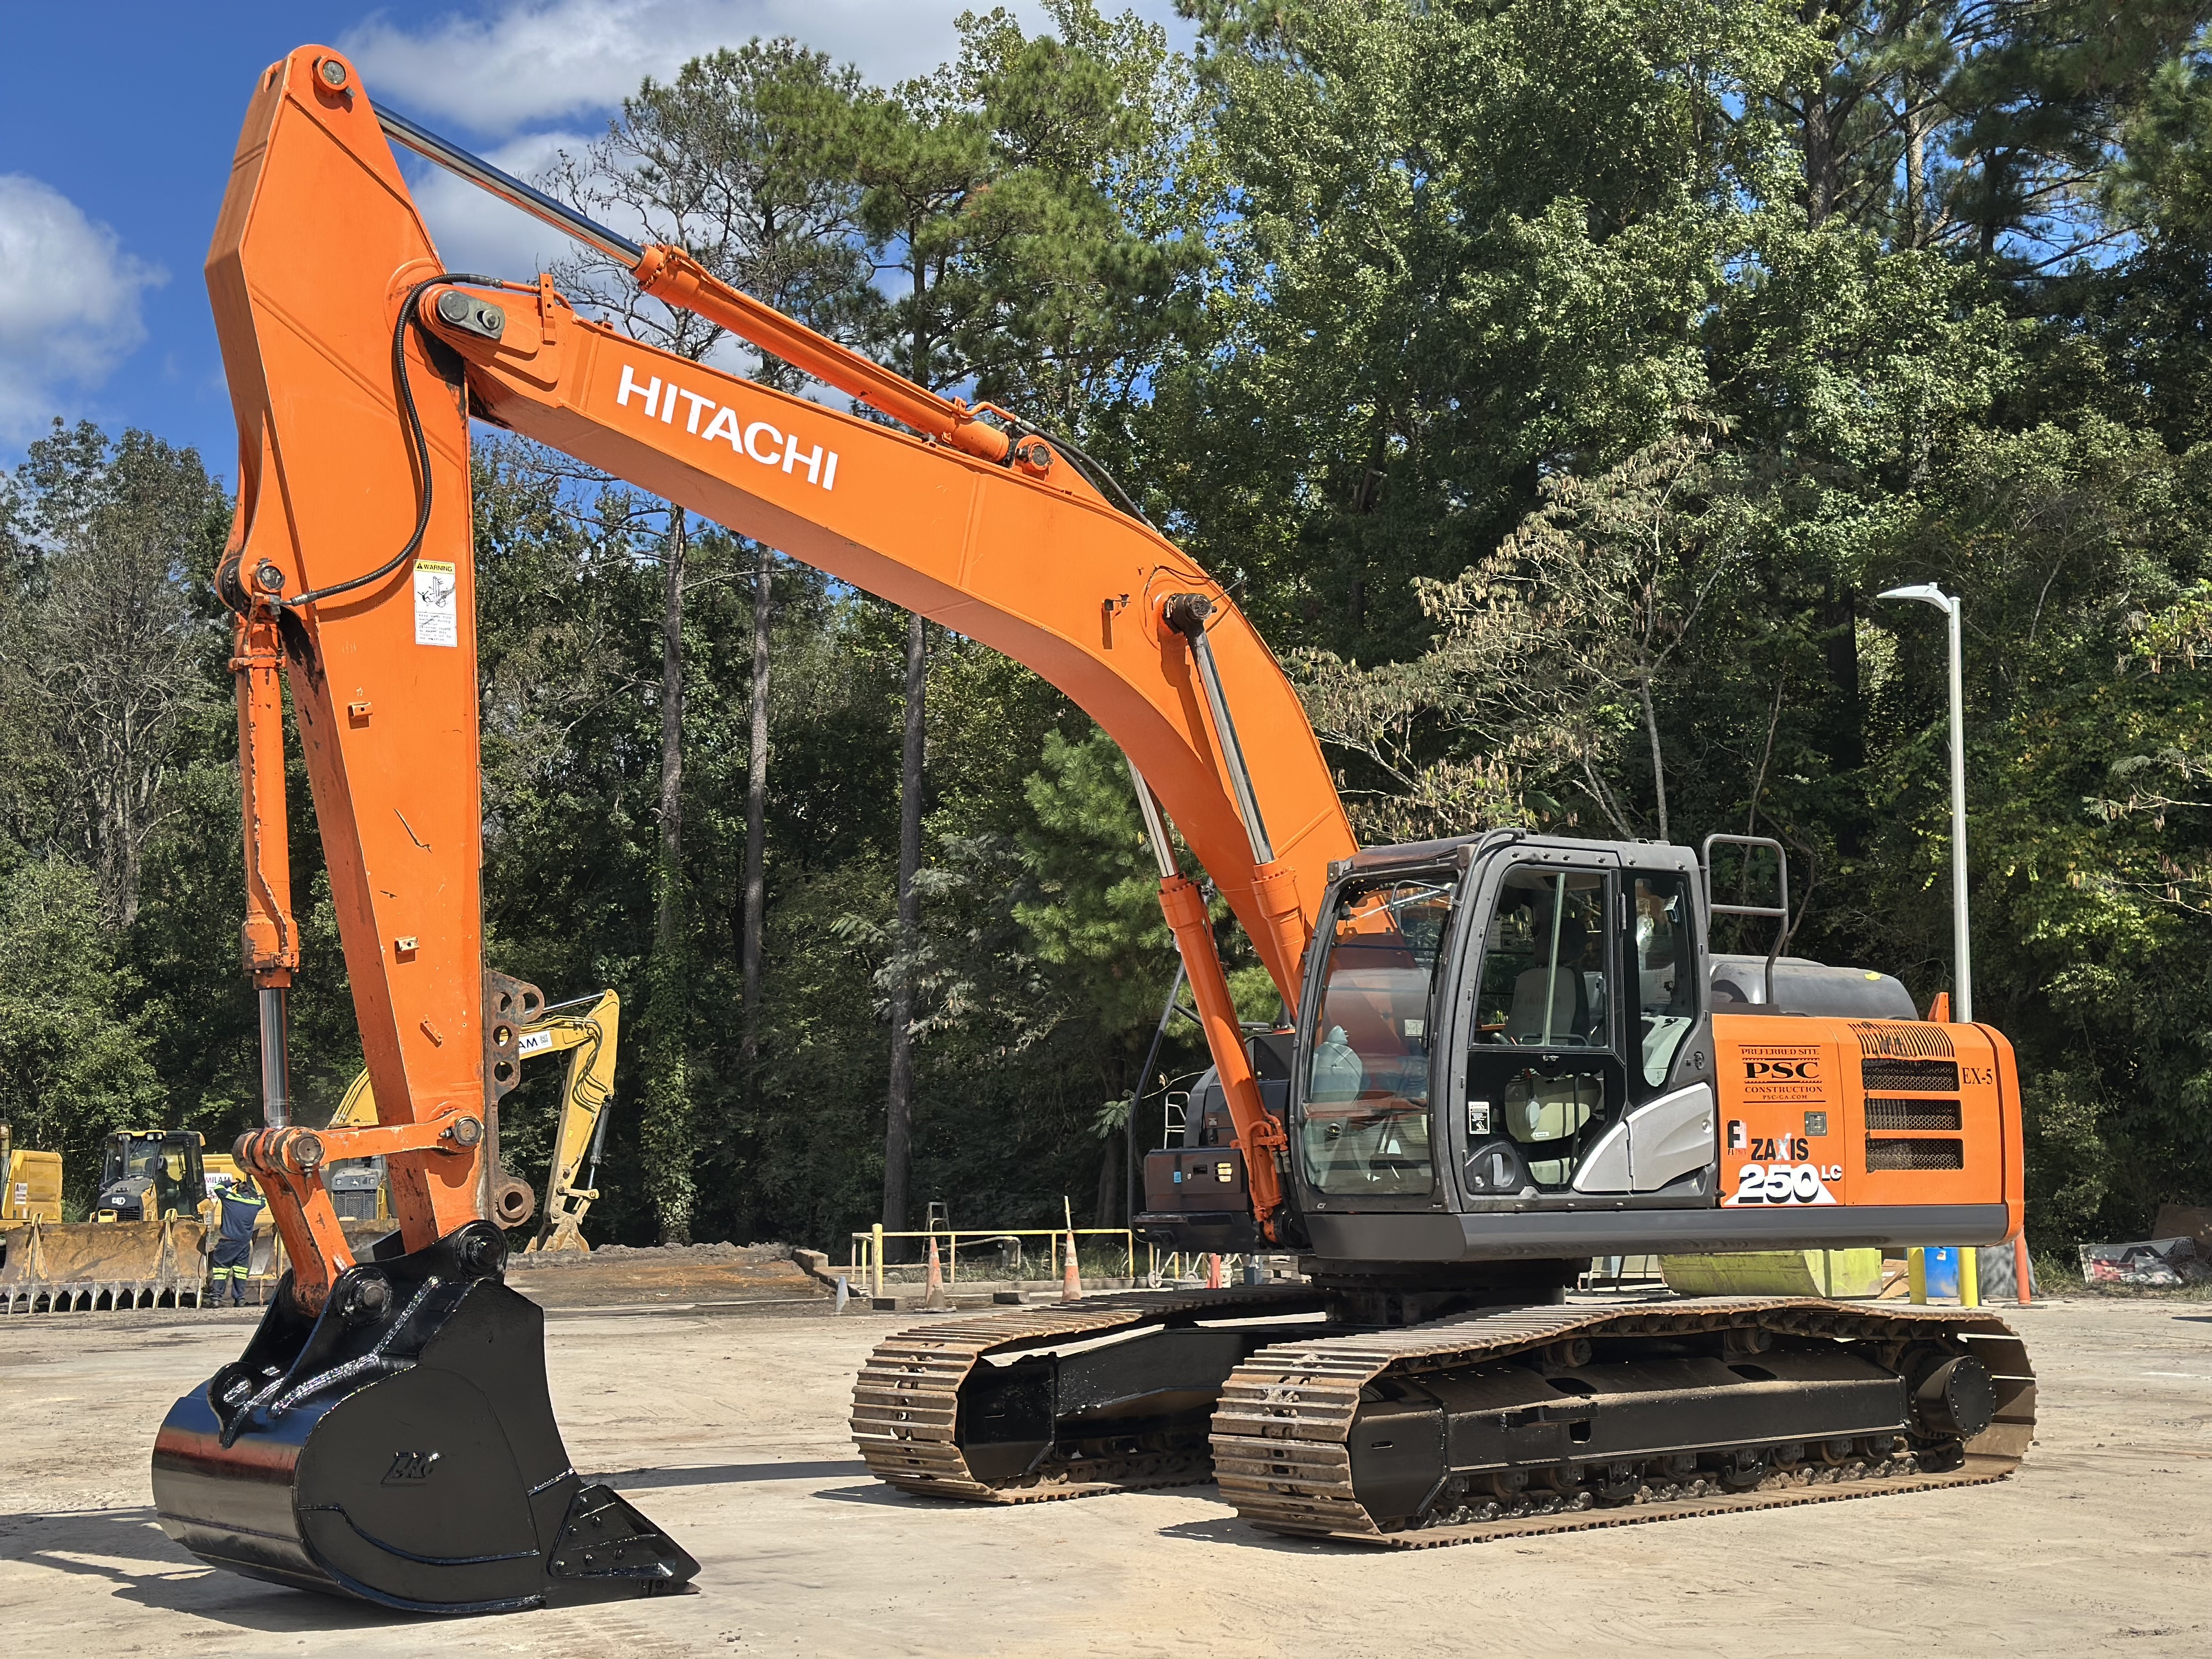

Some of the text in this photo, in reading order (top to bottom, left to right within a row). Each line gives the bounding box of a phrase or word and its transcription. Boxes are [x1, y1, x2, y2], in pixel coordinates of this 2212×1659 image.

[616, 364, 839, 492] HITACHI
[1743, 1062, 1819, 1079] PSC
[1961, 1067, 1993, 1085] EX-5
[1751, 1133, 1809, 1161] ZAXIS
[1737, 1164, 1842, 1204] 250 LC
